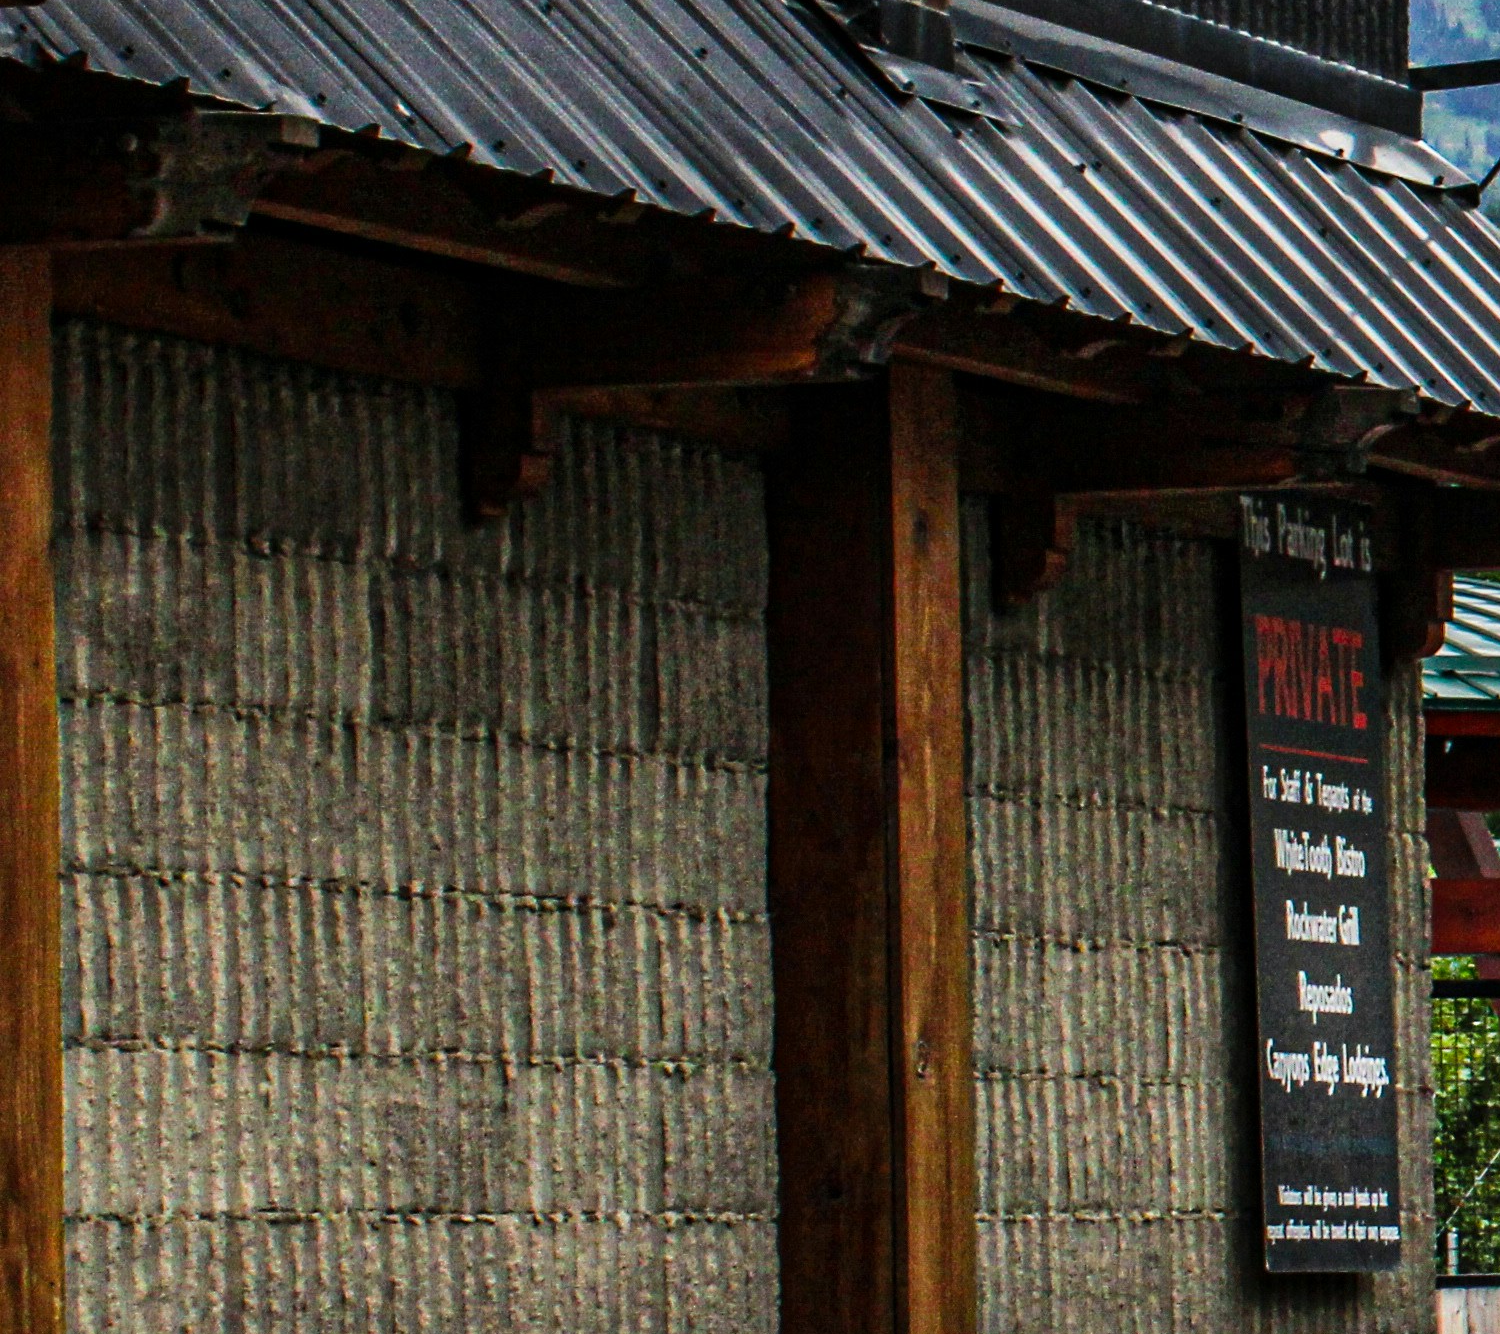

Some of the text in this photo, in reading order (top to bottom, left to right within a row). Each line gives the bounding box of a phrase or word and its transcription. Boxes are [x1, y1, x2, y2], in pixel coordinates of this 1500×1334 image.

[1239, 494, 1372, 581] This Parking Lot is
[1256, 613, 1367, 729] PRIVATE
[1263, 764, 1373, 815] For Staff & Tenants of the
[1335, 835, 1366, 878] Bistro
[1285, 899, 1361, 946] Rockwater Grill
[1297, 970, 1354, 1025] Reposados
[1266, 1037, 1311, 1093] Canyons
[1313, 1040, 1340, 1096] Edge
